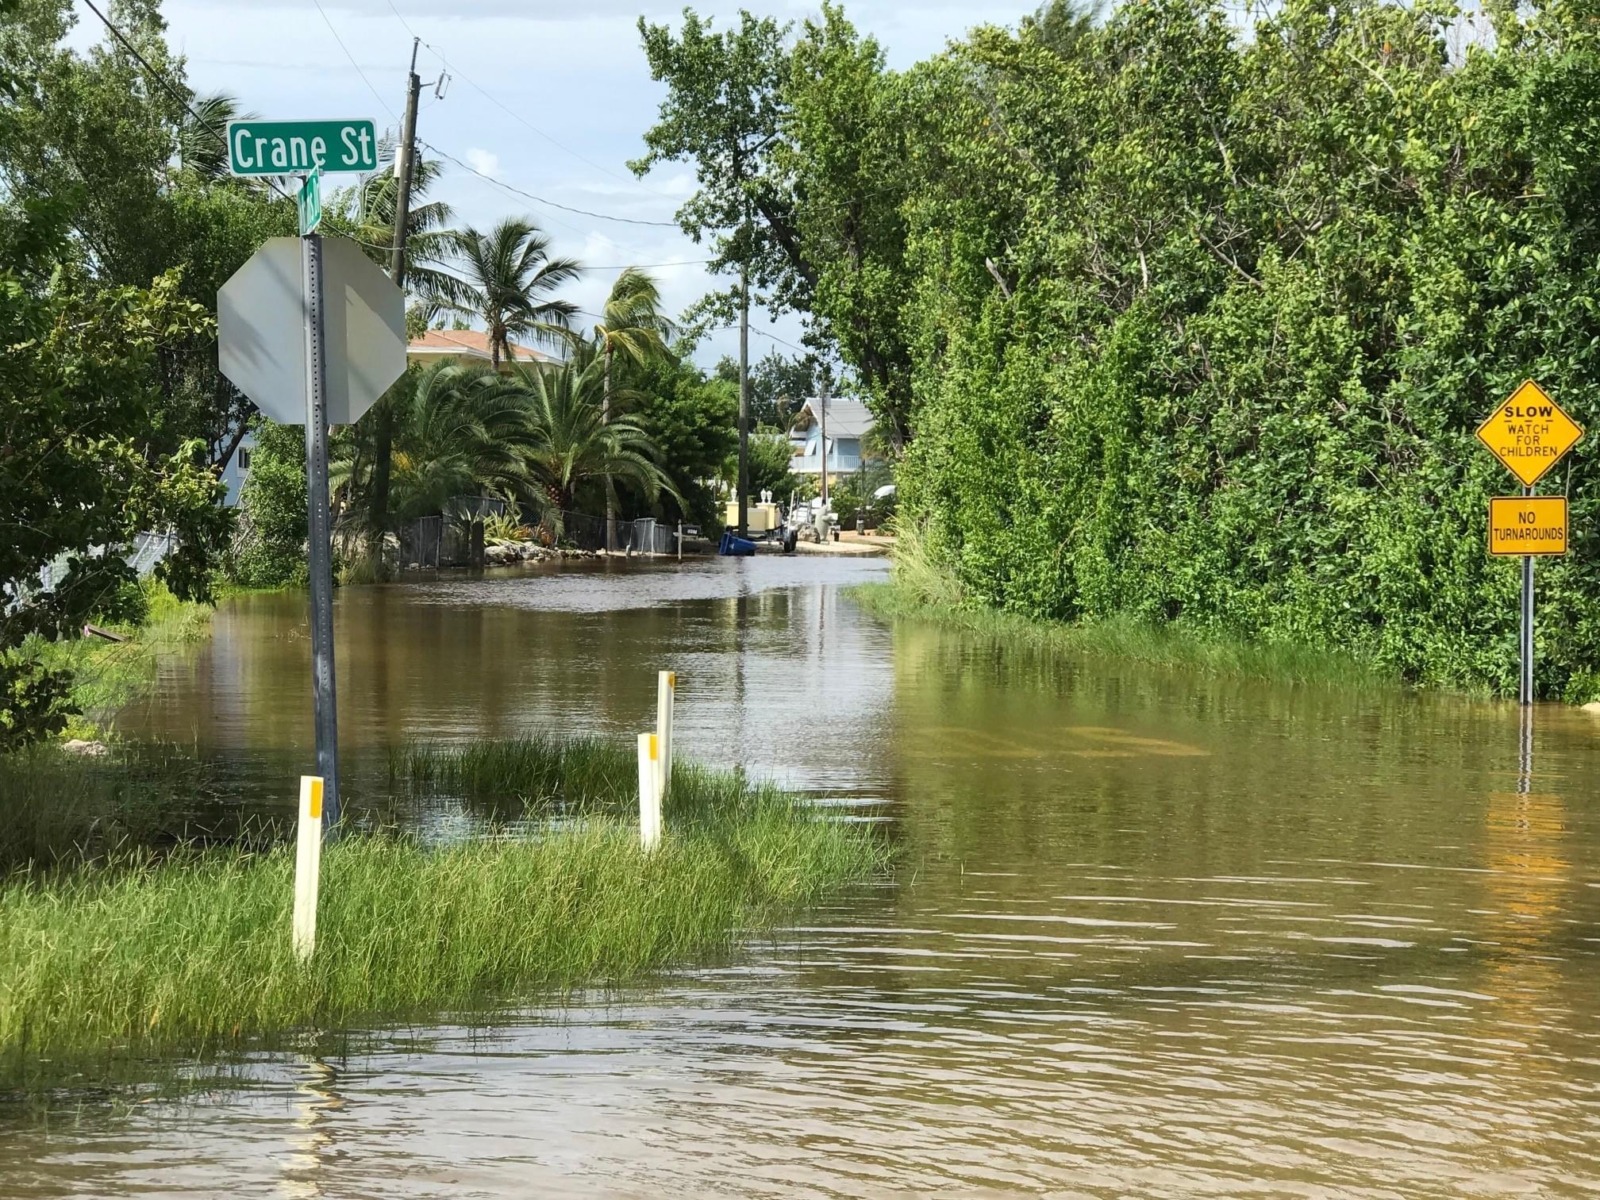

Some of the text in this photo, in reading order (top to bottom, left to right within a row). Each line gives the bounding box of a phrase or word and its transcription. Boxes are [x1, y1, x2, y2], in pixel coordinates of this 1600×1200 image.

[235, 126, 372, 168] Crane St
[1504, 407, 1553, 417] SLOW
[1508, 424, 1549, 435] WATCH
[1516, 435, 1540, 446] FOR
[1500, 446, 1558, 457] CHILDREN
[1518, 512, 1536, 524] NO
[1494, 527, 1564, 541] TURNAROUNDS
